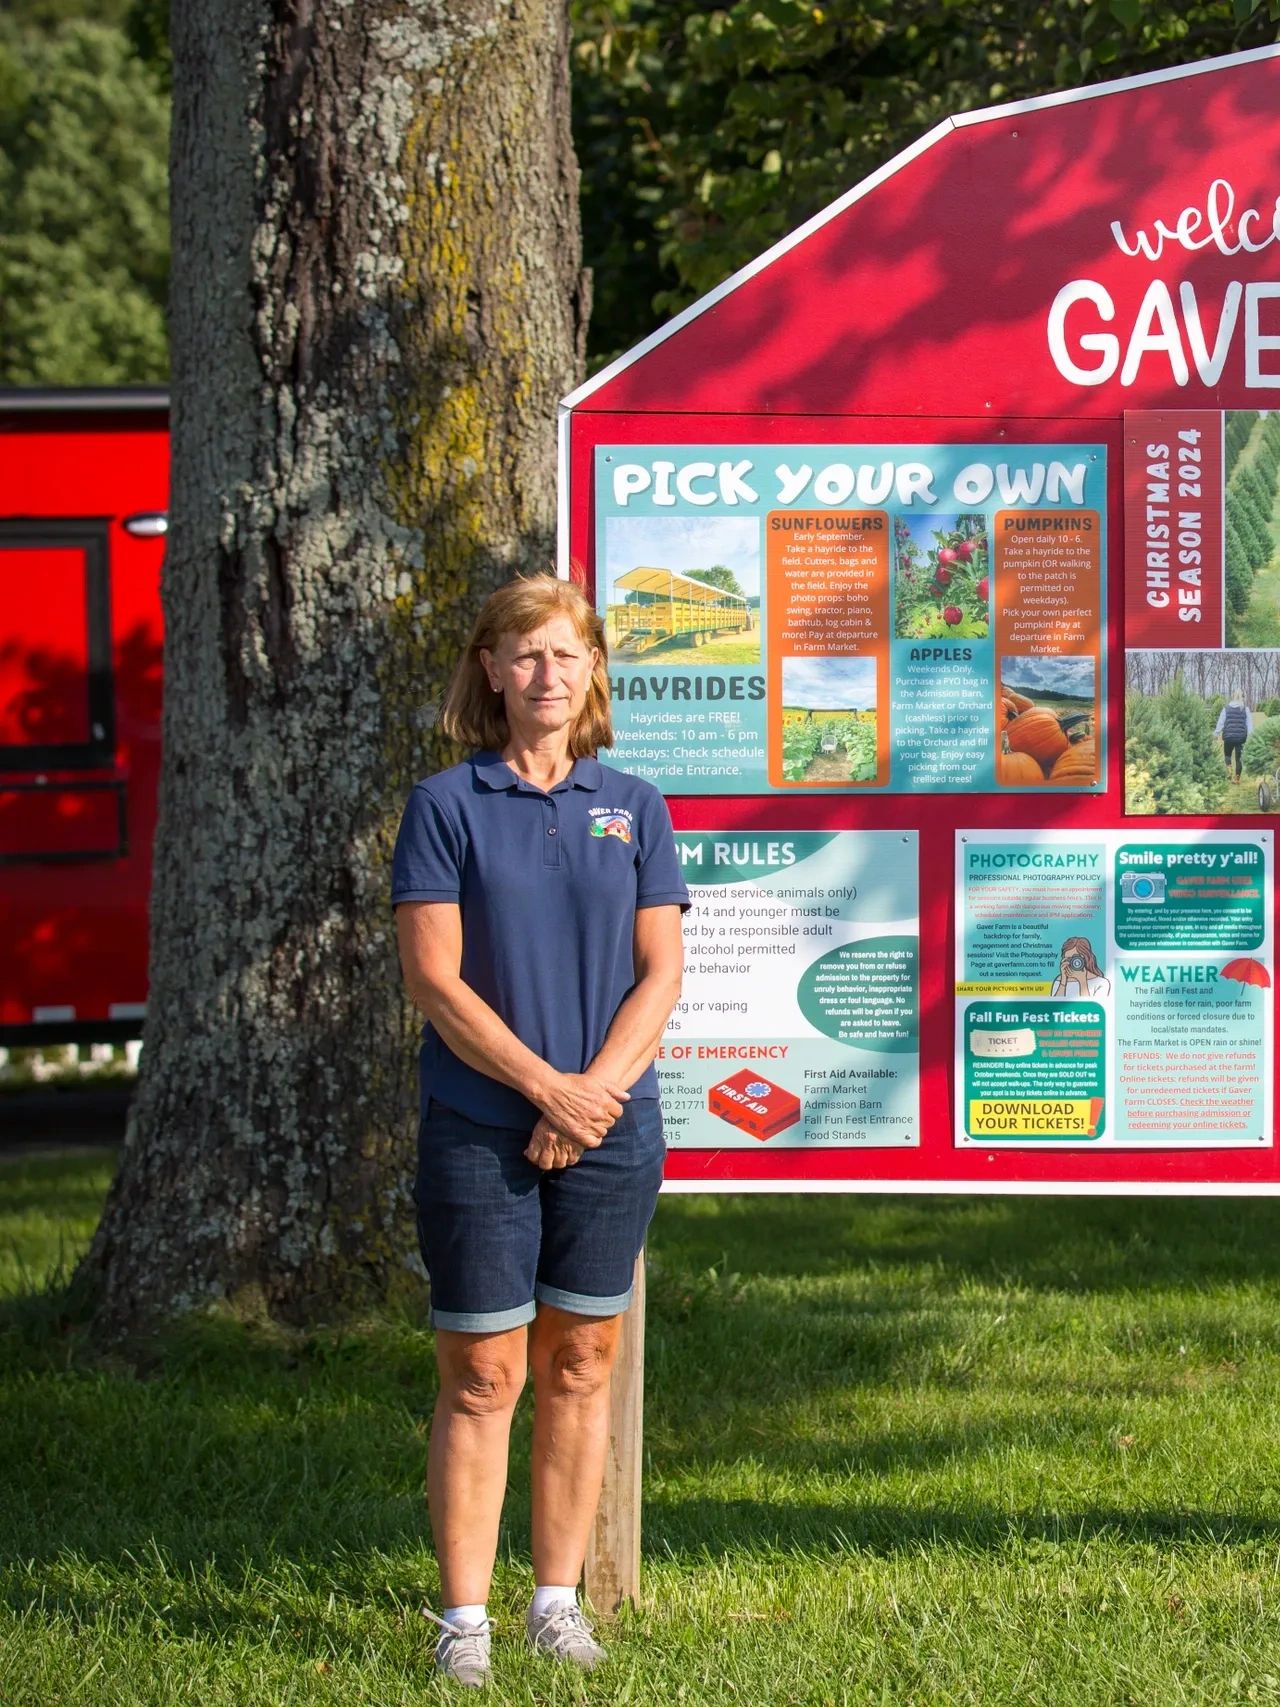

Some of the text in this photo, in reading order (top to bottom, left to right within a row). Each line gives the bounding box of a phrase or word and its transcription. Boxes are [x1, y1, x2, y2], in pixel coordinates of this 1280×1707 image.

[612, 460, 1087, 506] PICK YOUR OWN
[772, 518, 882, 531] SUNFLOWERS
[1004, 518, 1092, 531] PUMPKINS
[1146, 444, 1170, 608] CHRISTMAS
[1178, 429, 1201, 622] SEASON 2024
[794, 533, 864, 542] Early September.
[910, 648, 972, 660] APPLES
[608, 676, 766, 700] HAYRIDES
[631, 712, 740, 726] Hayrides are FREE!
[613, 730, 677, 742] Weekends:
[682, 730, 695, 740] 10
[698, 732, 717, 740] am
[728, 730, 735, 740] 6
[739, 732, 758, 742] pm
[714, 842, 797, 866] RULES
[970, 854, 1098, 867] PHOTOGRAPHY
[1120, 851, 1257, 867] Smile pretty y'all!
[731, 886, 856, 900] service animals only)
[1120, 966, 1218, 982] WEATHER
[970, 1012, 1099, 1022] Fall Fun Fest Tickets
[672, 1047, 692, 1058] OF
[698, 1046, 788, 1058] EMERGENCY
[804, 1069, 897, 1078] First Aid Available:
[716, 1084, 768, 1116] FIRST AID
[804, 1100, 882, 1109] Admission Barn
[983, 1104, 1074, 1114] DOWNLOAD
[976, 1118, 1084, 1129] YOUR TICKETS!
